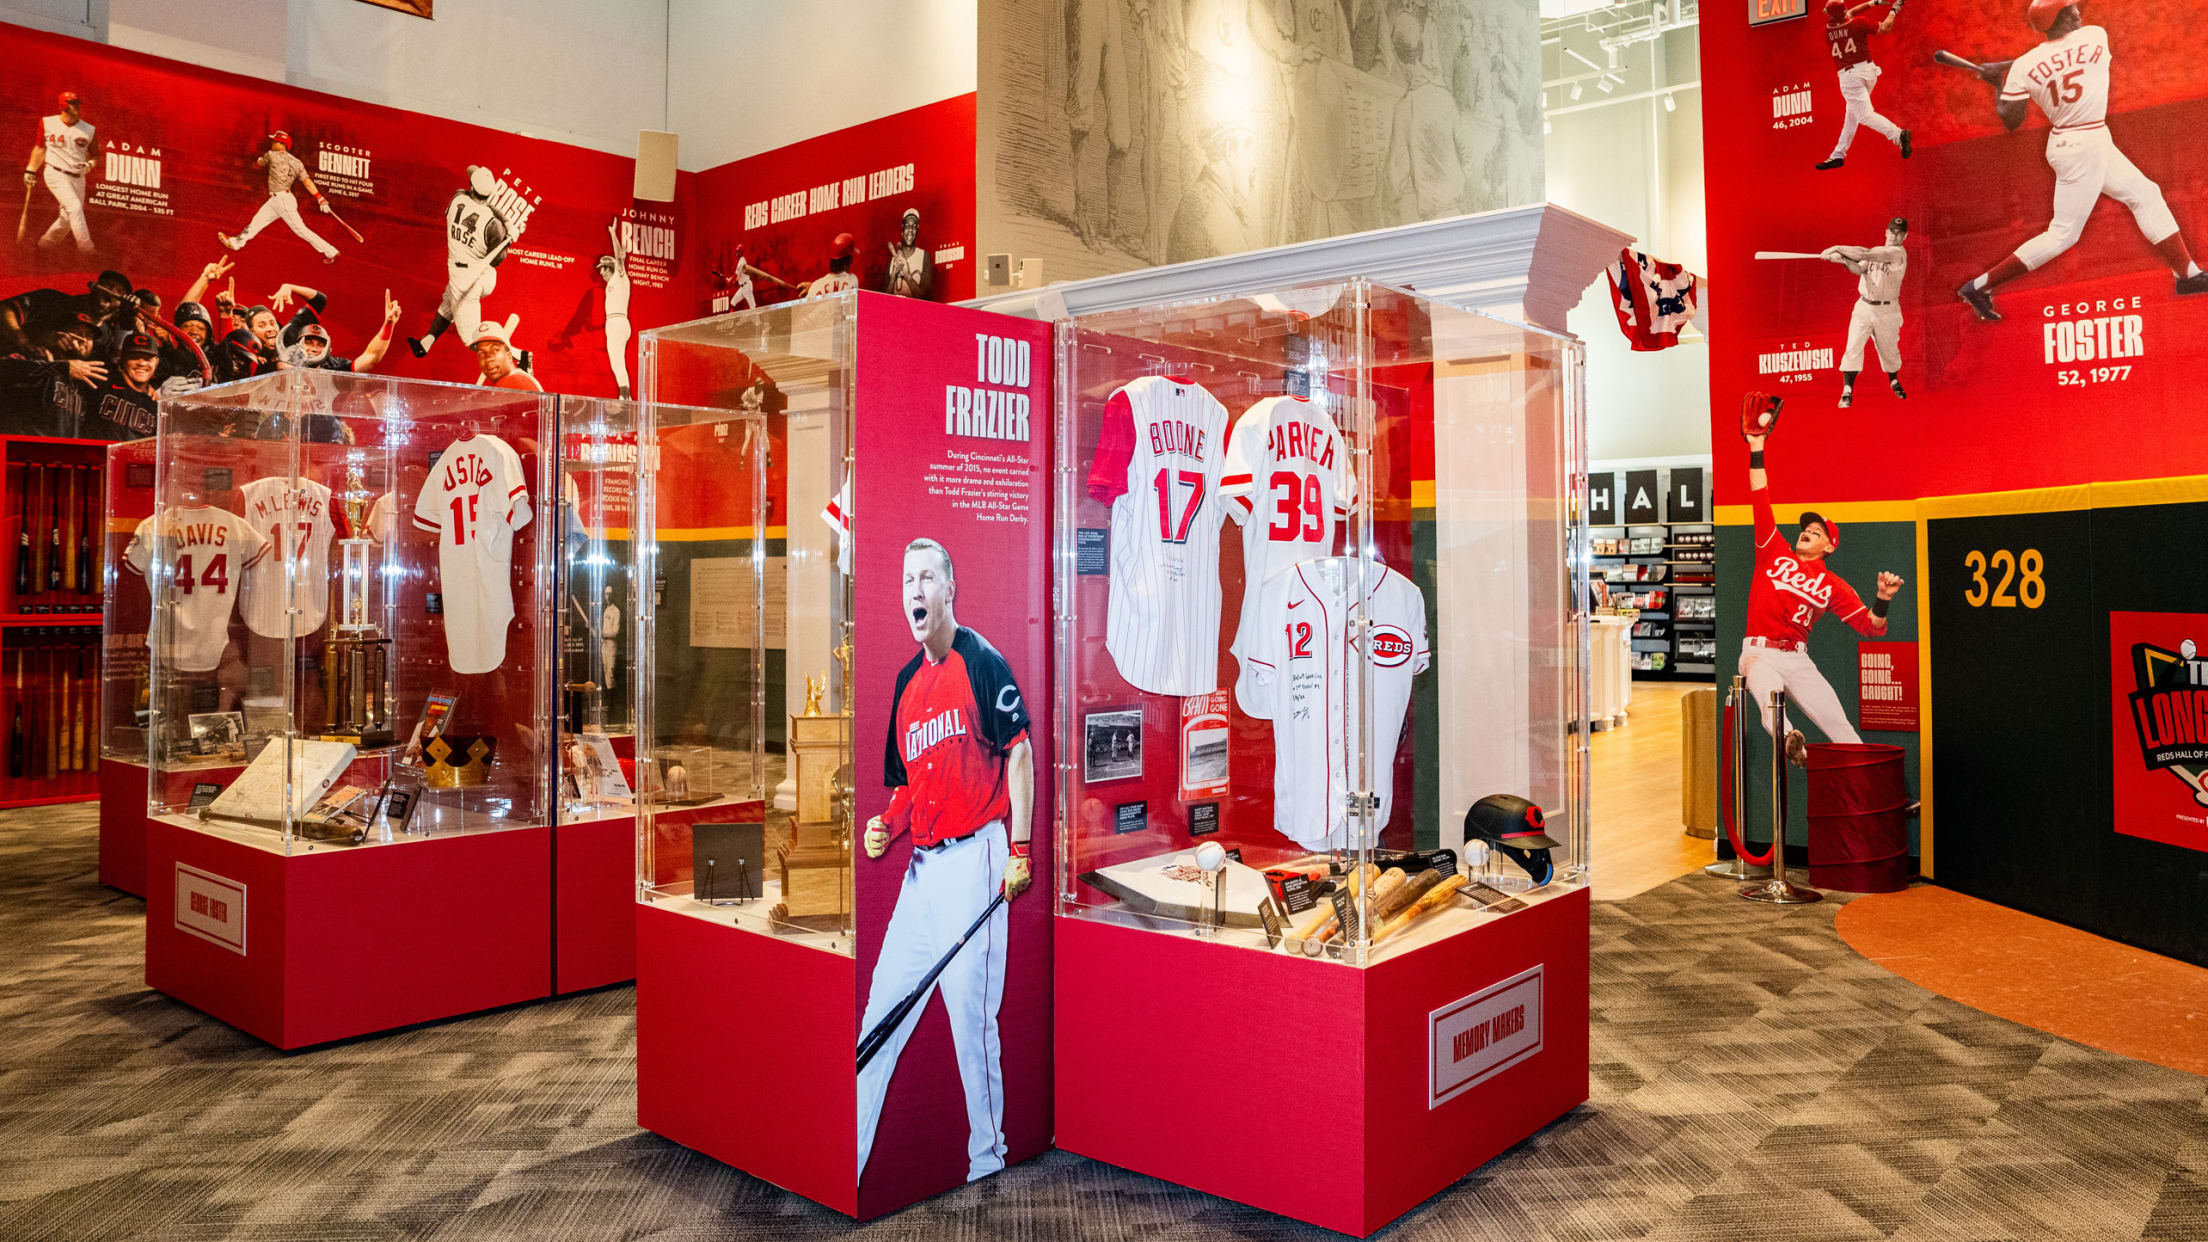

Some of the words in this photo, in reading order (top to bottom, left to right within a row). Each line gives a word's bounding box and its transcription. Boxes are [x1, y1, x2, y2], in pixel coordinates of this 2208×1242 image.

[1828, 29, 1849, 40] DUNN
[1831, 38, 1857, 59] 44
[2028, 44, 2104, 86] FOSTER
[1773, 82, 1810, 94] ADAM
[2046, 68, 2084, 107] 15
[1772, 90, 1812, 118] DUNN
[1772, 120, 1788, 130] 46,
[1789, 116, 1813, 128] 2004
[106, 140, 160, 157] ADAM
[319, 142, 371, 157] SCOOTER
[106, 152, 161, 188] DUNN
[319, 150, 370, 179] GENNETT
[314, 172, 329, 180] FIRST
[96, 183, 130, 194] LONGEST
[130, 188, 152, 198] HOME
[153, 191, 168, 200] RUN
[328, 188, 342, 196] JUNE
[331, 182, 346, 190] RUNS
[503, 168, 542, 205] PETE
[96, 190, 106, 198] AT
[106, 192, 130, 202] GREAT
[130, 196, 168, 208] AMERICAN
[487, 178, 535, 230] ROSE
[744, 201, 768, 231] REDS
[771, 190, 807, 224] CAREER
[810, 182, 840, 214] HOME
[842, 175, 866, 207] RUN
[869, 163, 914, 200] LEADERS
[89, 198, 108, 206] BALL
[108, 200, 129, 210] PARK,
[130, 203, 148, 212] 2004
[166, 208, 174, 216] FT
[622, 208, 674, 224] JOHNNY
[454, 203, 479, 234] 14
[451, 225, 476, 248] ROSE
[622, 221, 674, 260] BENCH
[508, 248, 524, 256] MOST
[524, 250, 548, 260] CAREER
[548, 254, 575, 264] LEAD-OFF
[520, 258, 538, 266] HOME
[630, 256, 644, 264] FINAL
[646, 259, 667, 267] CAREER
[646, 266, 658, 274] RUN
[650, 274, 670, 282] BENCH
[2043, 296, 2142, 318] GEORGE
[1780, 341, 1810, 350] TED
[2043, 314, 2144, 364] FOSTER
[975, 333, 1030, 388] TODD
[1758, 347, 1834, 375] KLUSZEWSKI
[1780, 374, 1793, 384] 47,
[1794, 374, 1812, 382] 1955
[2058, 370, 2086, 388] 52,
[2090, 365, 2132, 383] 1977
[945, 385, 1030, 442] FRAZIER
[1150, 420, 1206, 463] BOONE
[1268, 421, 1334, 470] PARKER
[947, 450, 970, 462] During
[970, 452, 1005, 462] Cincinnati's
[1006, 455, 1028, 464] All-Star
[956, 464, 964, 472] of
[965, 464, 982, 474] 2015,
[1009, 468, 1028, 476] carried
[924, 474, 938, 482] with
[963, 476, 982, 484] drama
[983, 477, 994, 486] and
[996, 478, 1028, 487] exhilaration
[928, 486, 944, 495] than
[944, 487, 960, 496] Todd
[961, 488, 986, 497] Frazier's
[987, 490, 1008, 500] stirring
[1010, 490, 1028, 502] victory
[952, 500, 958, 508] in
[960, 500, 970, 508] the
[972, 501, 986, 509] MLB
[988, 501, 1010, 510] All-Star
[1012, 502, 1028, 510] Game
[1153, 468, 1206, 544] 17
[1268, 471, 1325, 543] 39
[976, 512, 994, 521] Home
[996, 514, 1008, 522] Run
[1010, 514, 1028, 525] Derby.
[174, 524, 228, 550] DAVIS
[270, 522, 312, 562] 17
[174, 554, 228, 594] 44
[1766, 556, 1832, 602] Reds
[1964, 548, 2046, 608] 328
[1792, 604, 1814, 626] 29
[1285, 621, 1313, 660] 12
[1374, 639, 1412, 654] REDS
[1861, 653, 1894, 671] GOING,
[1861, 670, 1902, 684] GOING...
[1862, 685, 1902, 701] CAUGHT!
[1210, 704, 1228, 712] GONE
[906, 708, 966, 762] NATIONAL
[2156, 751, 2174, 762] REDS
[2175, 750, 2192, 760] HALL
[2194, 750, 2204, 759] OF
[2176, 814, 2198, 824] PRESENTED
[1454, 1020, 1490, 1064] MEMORY
[1492, 1004, 1525, 1044] MAKERS
